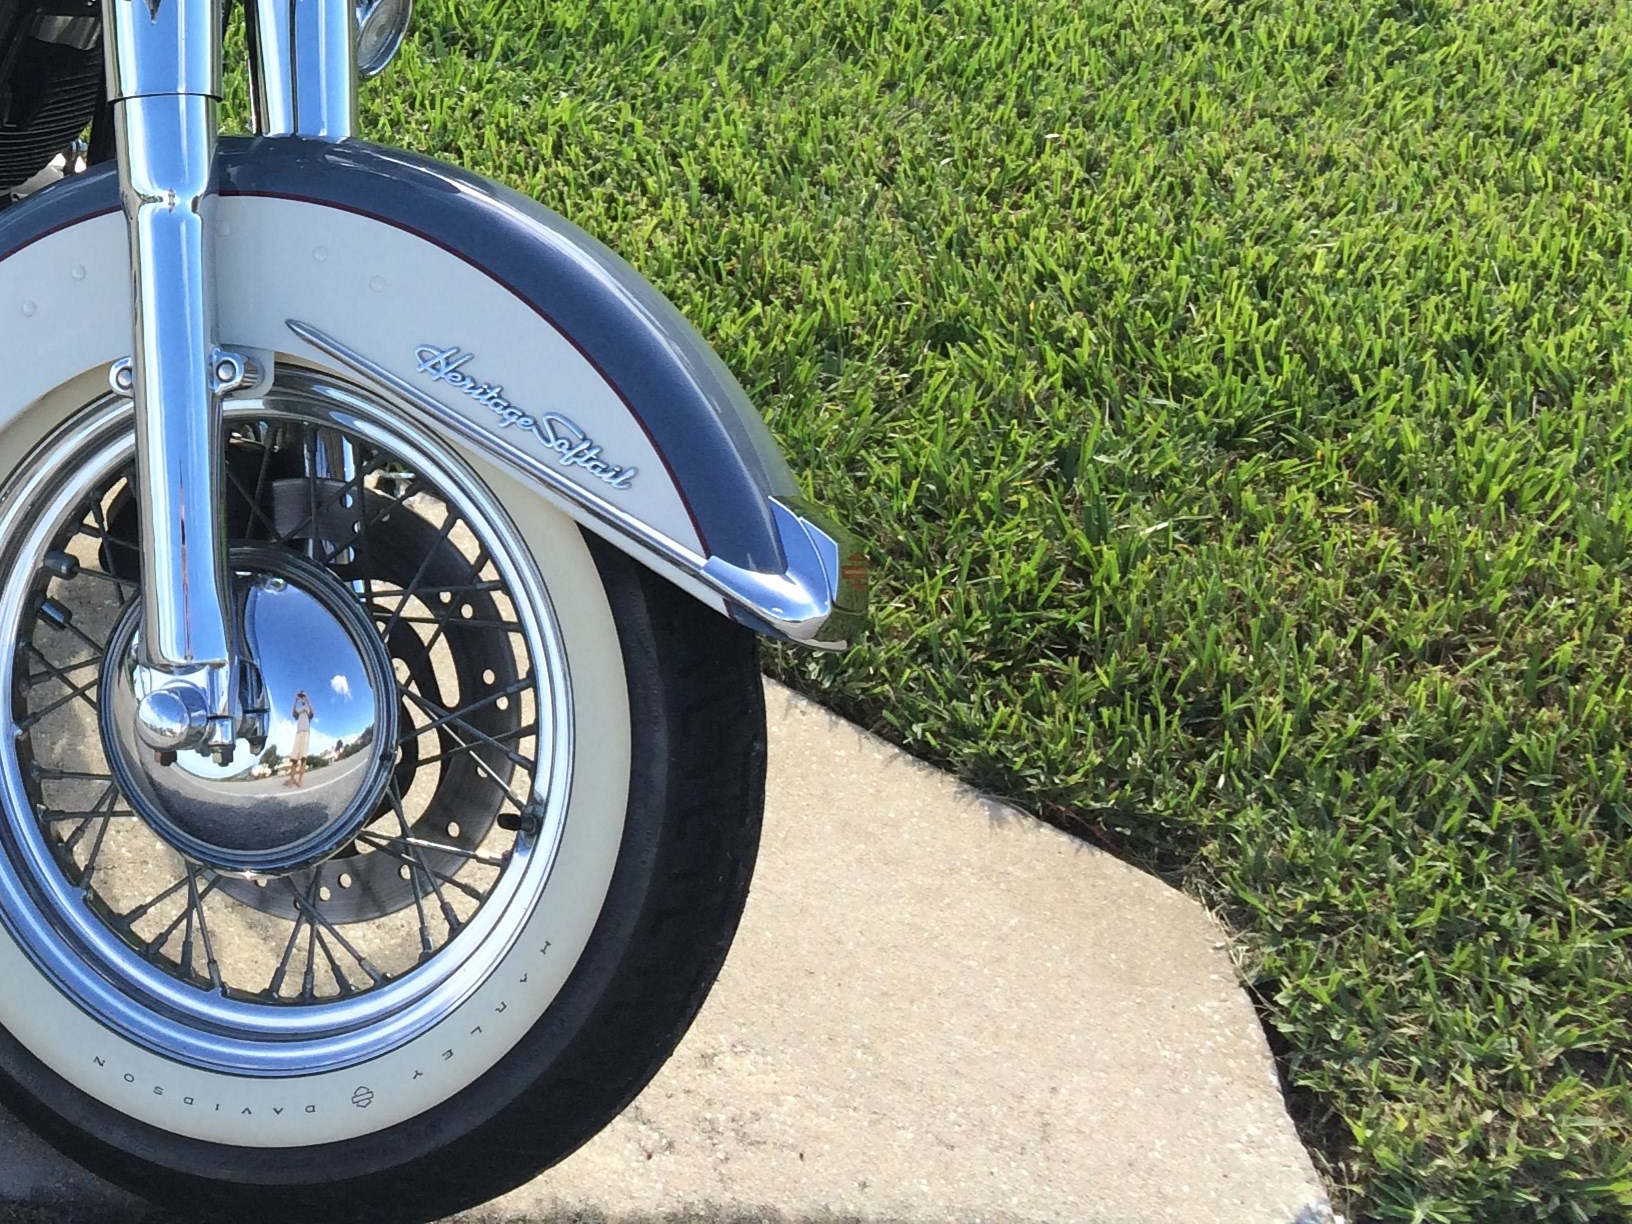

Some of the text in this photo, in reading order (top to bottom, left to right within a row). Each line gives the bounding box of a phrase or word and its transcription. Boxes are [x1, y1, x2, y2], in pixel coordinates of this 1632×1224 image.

[414, 344, 639, 489] Heritage Softail
[93, 939, 552, 1116] HARLEY DAVIDSON
